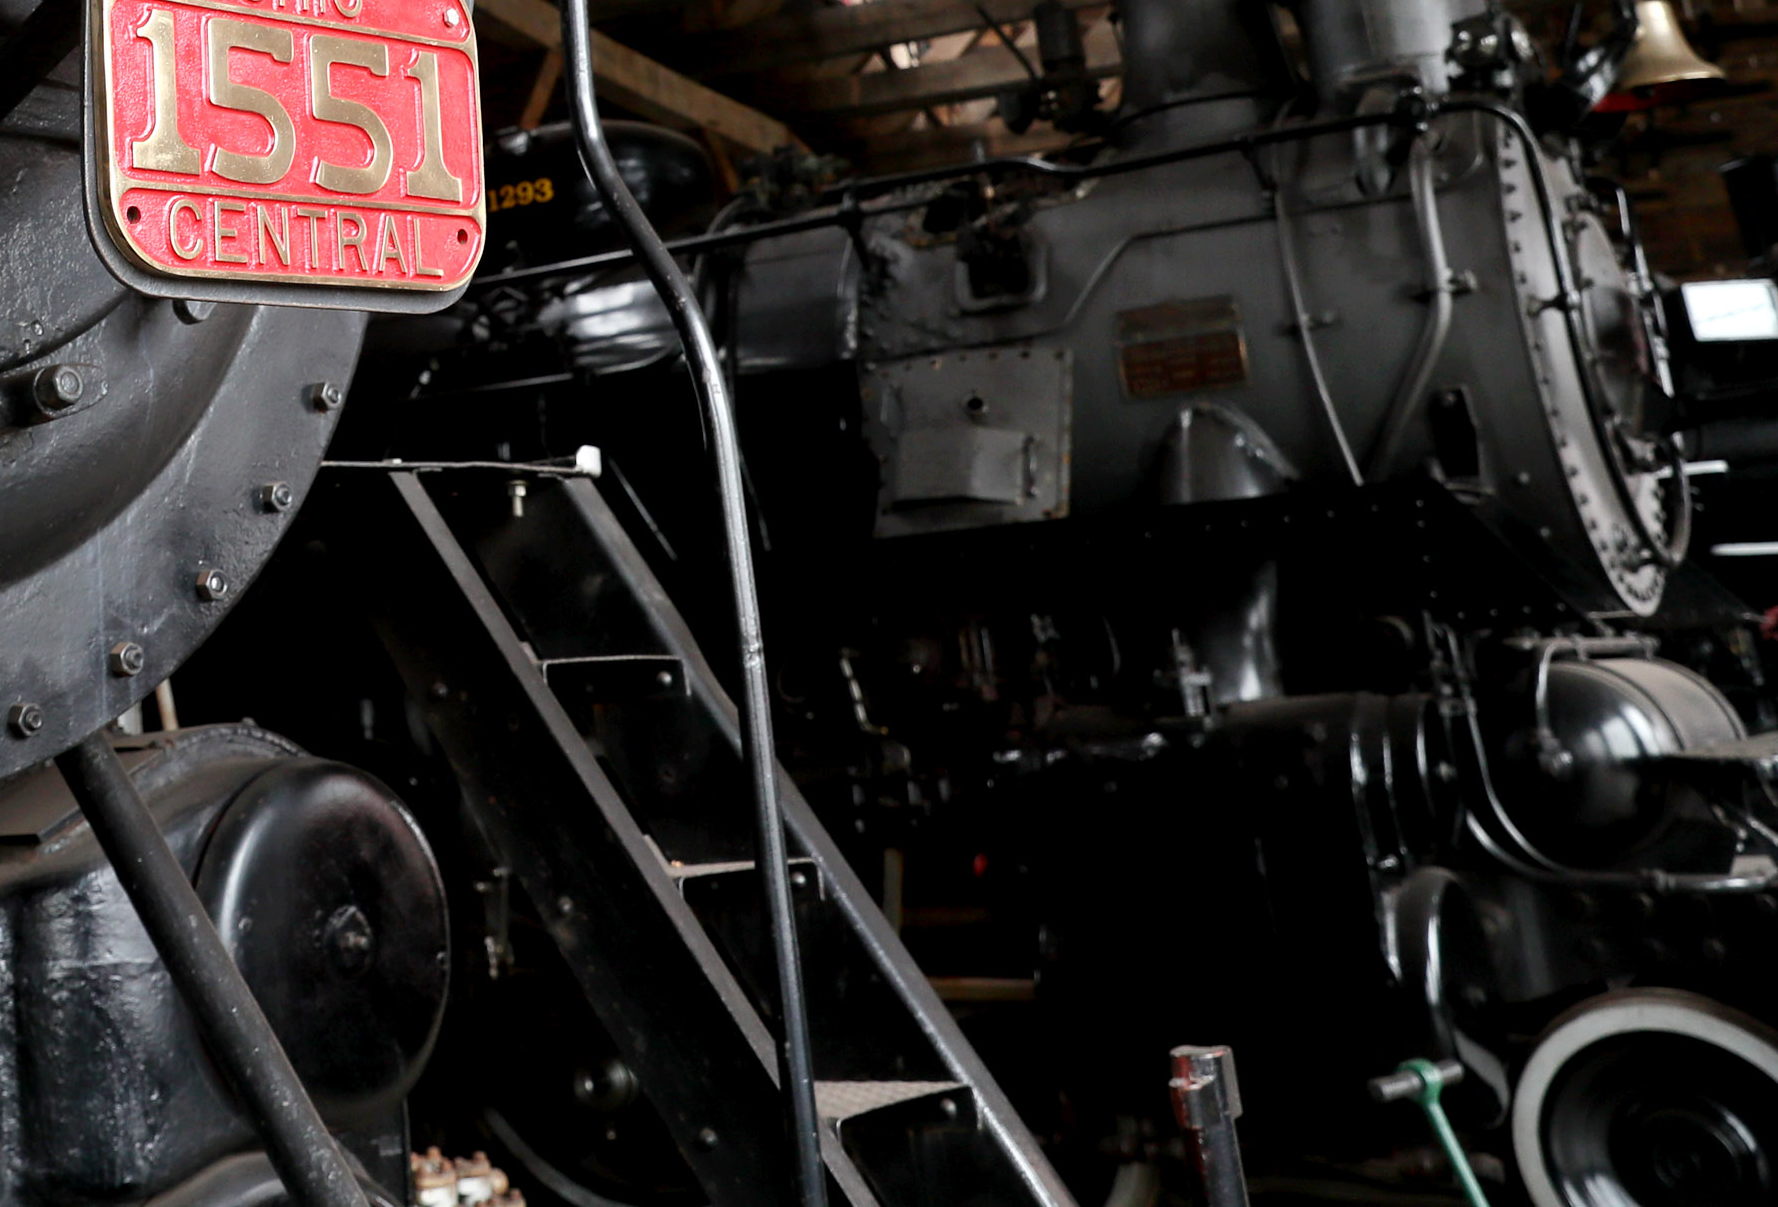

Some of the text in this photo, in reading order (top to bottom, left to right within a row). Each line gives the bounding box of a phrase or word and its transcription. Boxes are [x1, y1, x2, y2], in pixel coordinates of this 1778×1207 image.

[131, 8, 463, 204] 1551
[487, 176, 555, 213] 1293
[169, 198, 445, 279] CENTRAL
